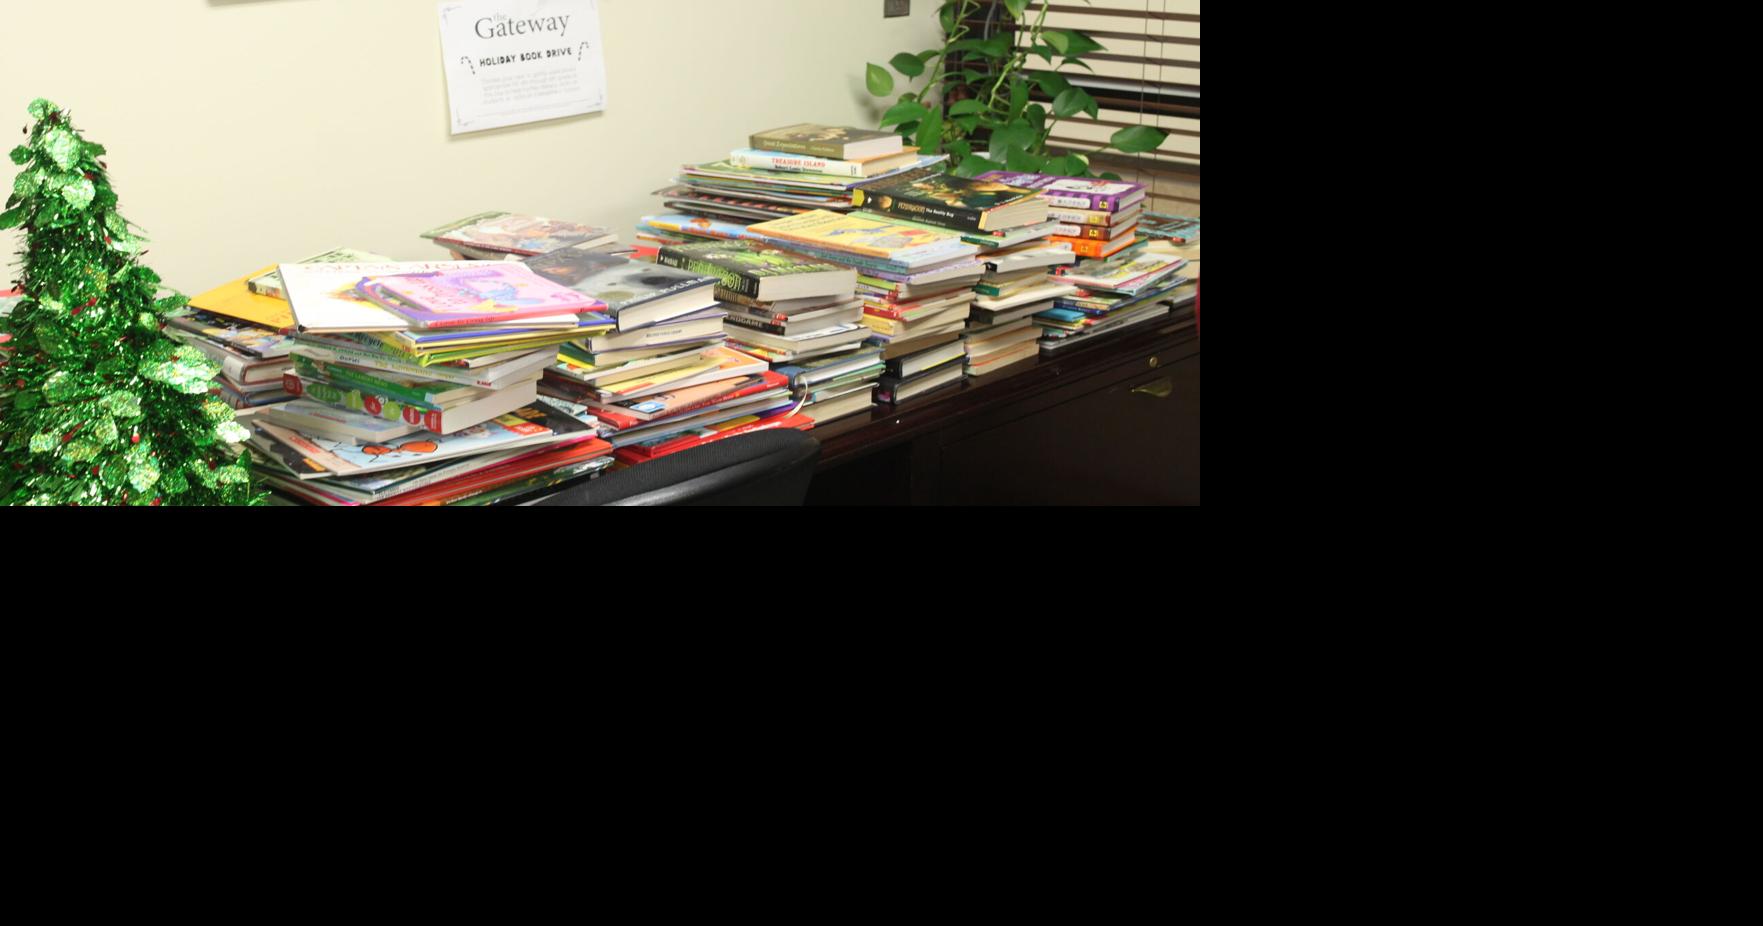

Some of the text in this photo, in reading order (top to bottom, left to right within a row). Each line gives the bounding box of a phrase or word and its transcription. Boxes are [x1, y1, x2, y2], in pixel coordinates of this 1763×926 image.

[474, 14, 571, 40] Gateway
[479, 47, 572, 67] HOLIDAY BOOK DRIVE
[772, 157, 826, 168] TREASURE ISLAND
